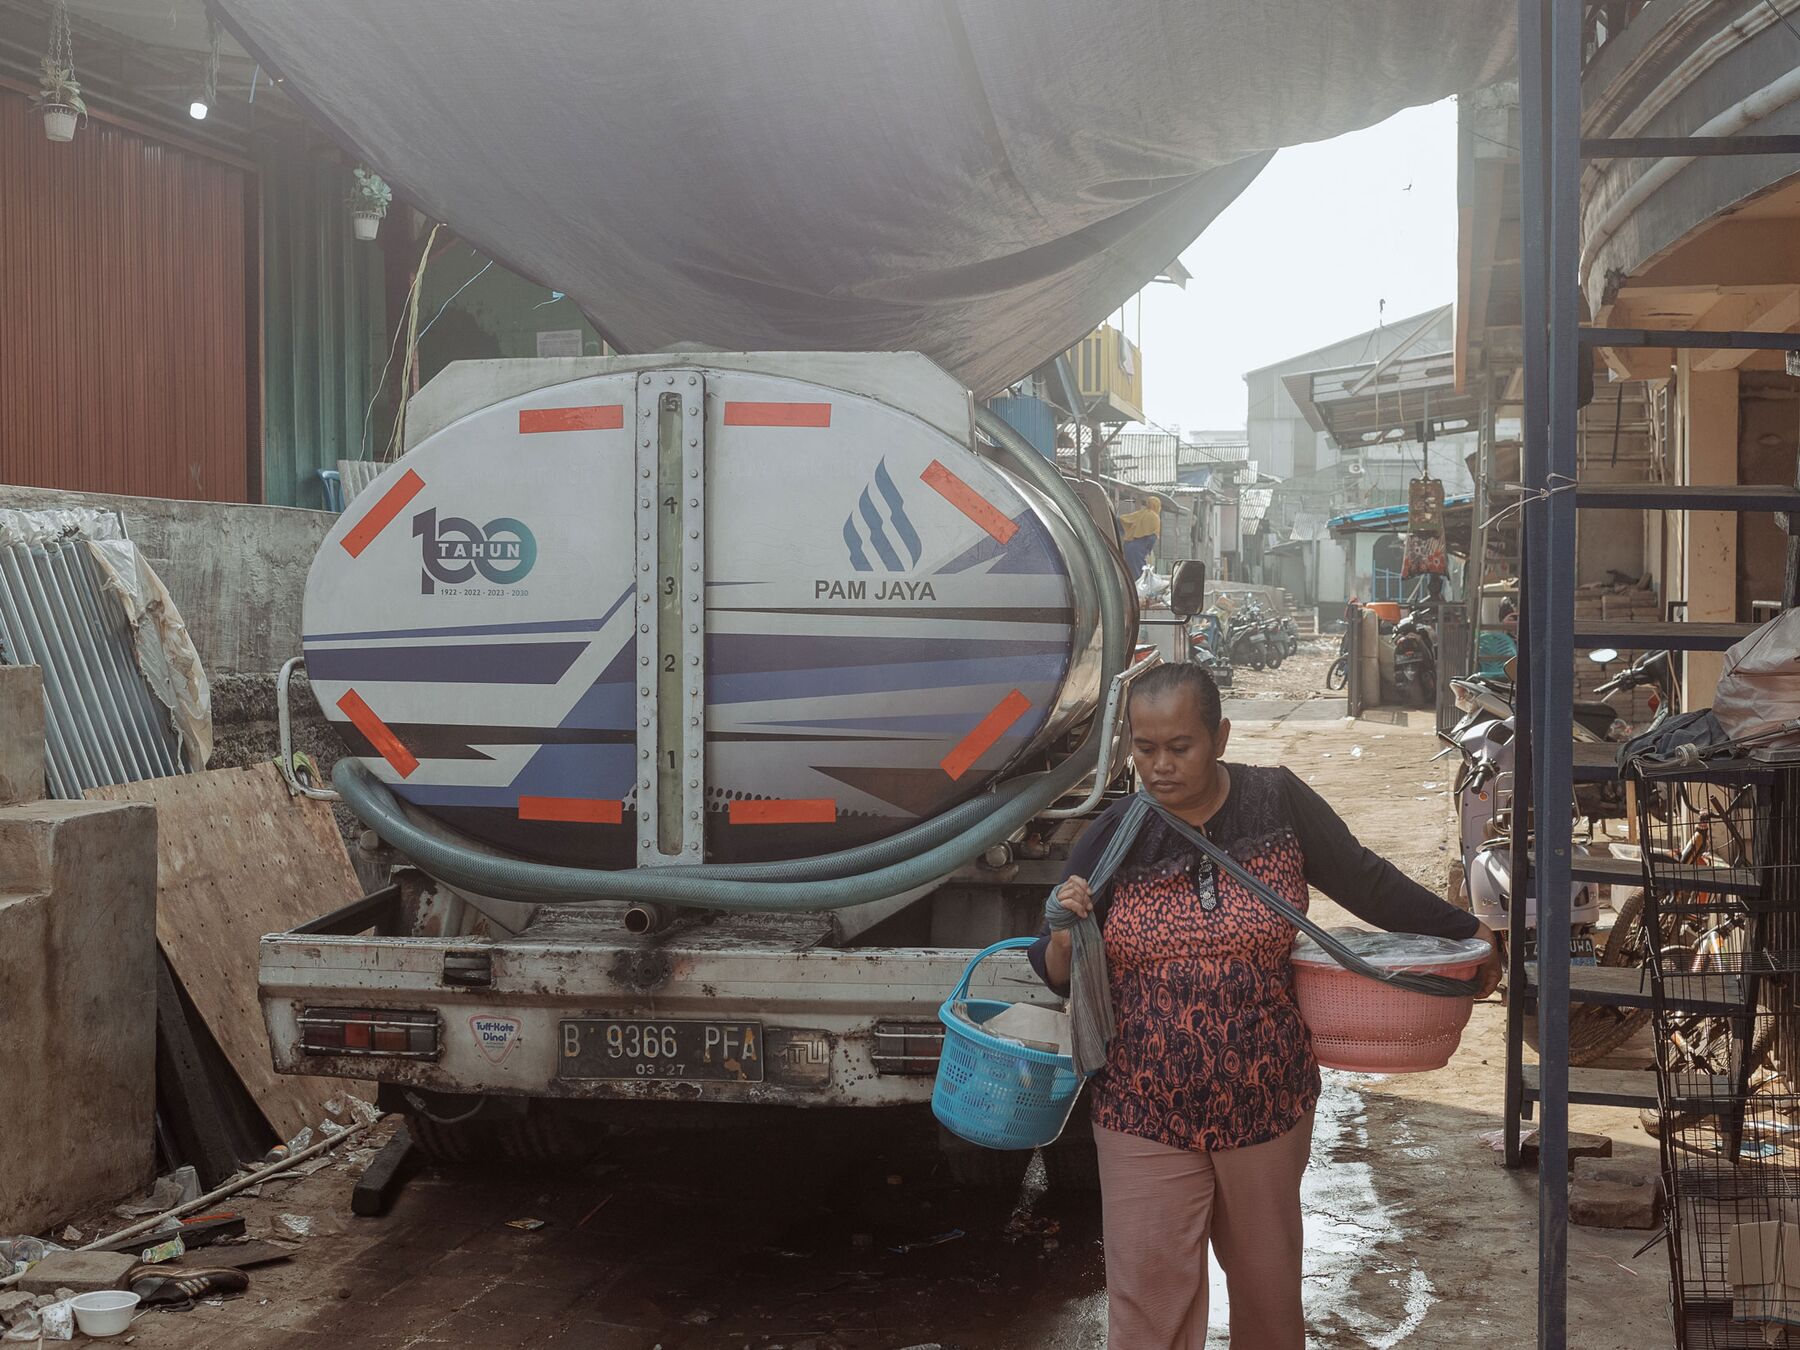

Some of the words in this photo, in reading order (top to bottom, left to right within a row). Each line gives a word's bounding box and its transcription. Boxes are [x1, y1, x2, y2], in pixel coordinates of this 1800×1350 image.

[663, 496, 678, 514] 4
[412, 507, 537, 594] 100
[438, 543, 520, 558] TAHUN
[440, 588, 457, 596] 1922
[464, 588, 481, 596] 2022
[487, 588, 505, 597] 2023
[664, 576, 676, 596] 3
[815, 580, 866, 600] PAM
[874, 581, 937, 601] JAYA
[664, 653, 676, 673] 2
[667, 750, 676, 769] 1
[483, 1032, 507, 1042] Dinol
[564, 1024, 581, 1058] B
[606, 1024, 678, 1059] 9366
[703, 1025, 757, 1061] PFA
